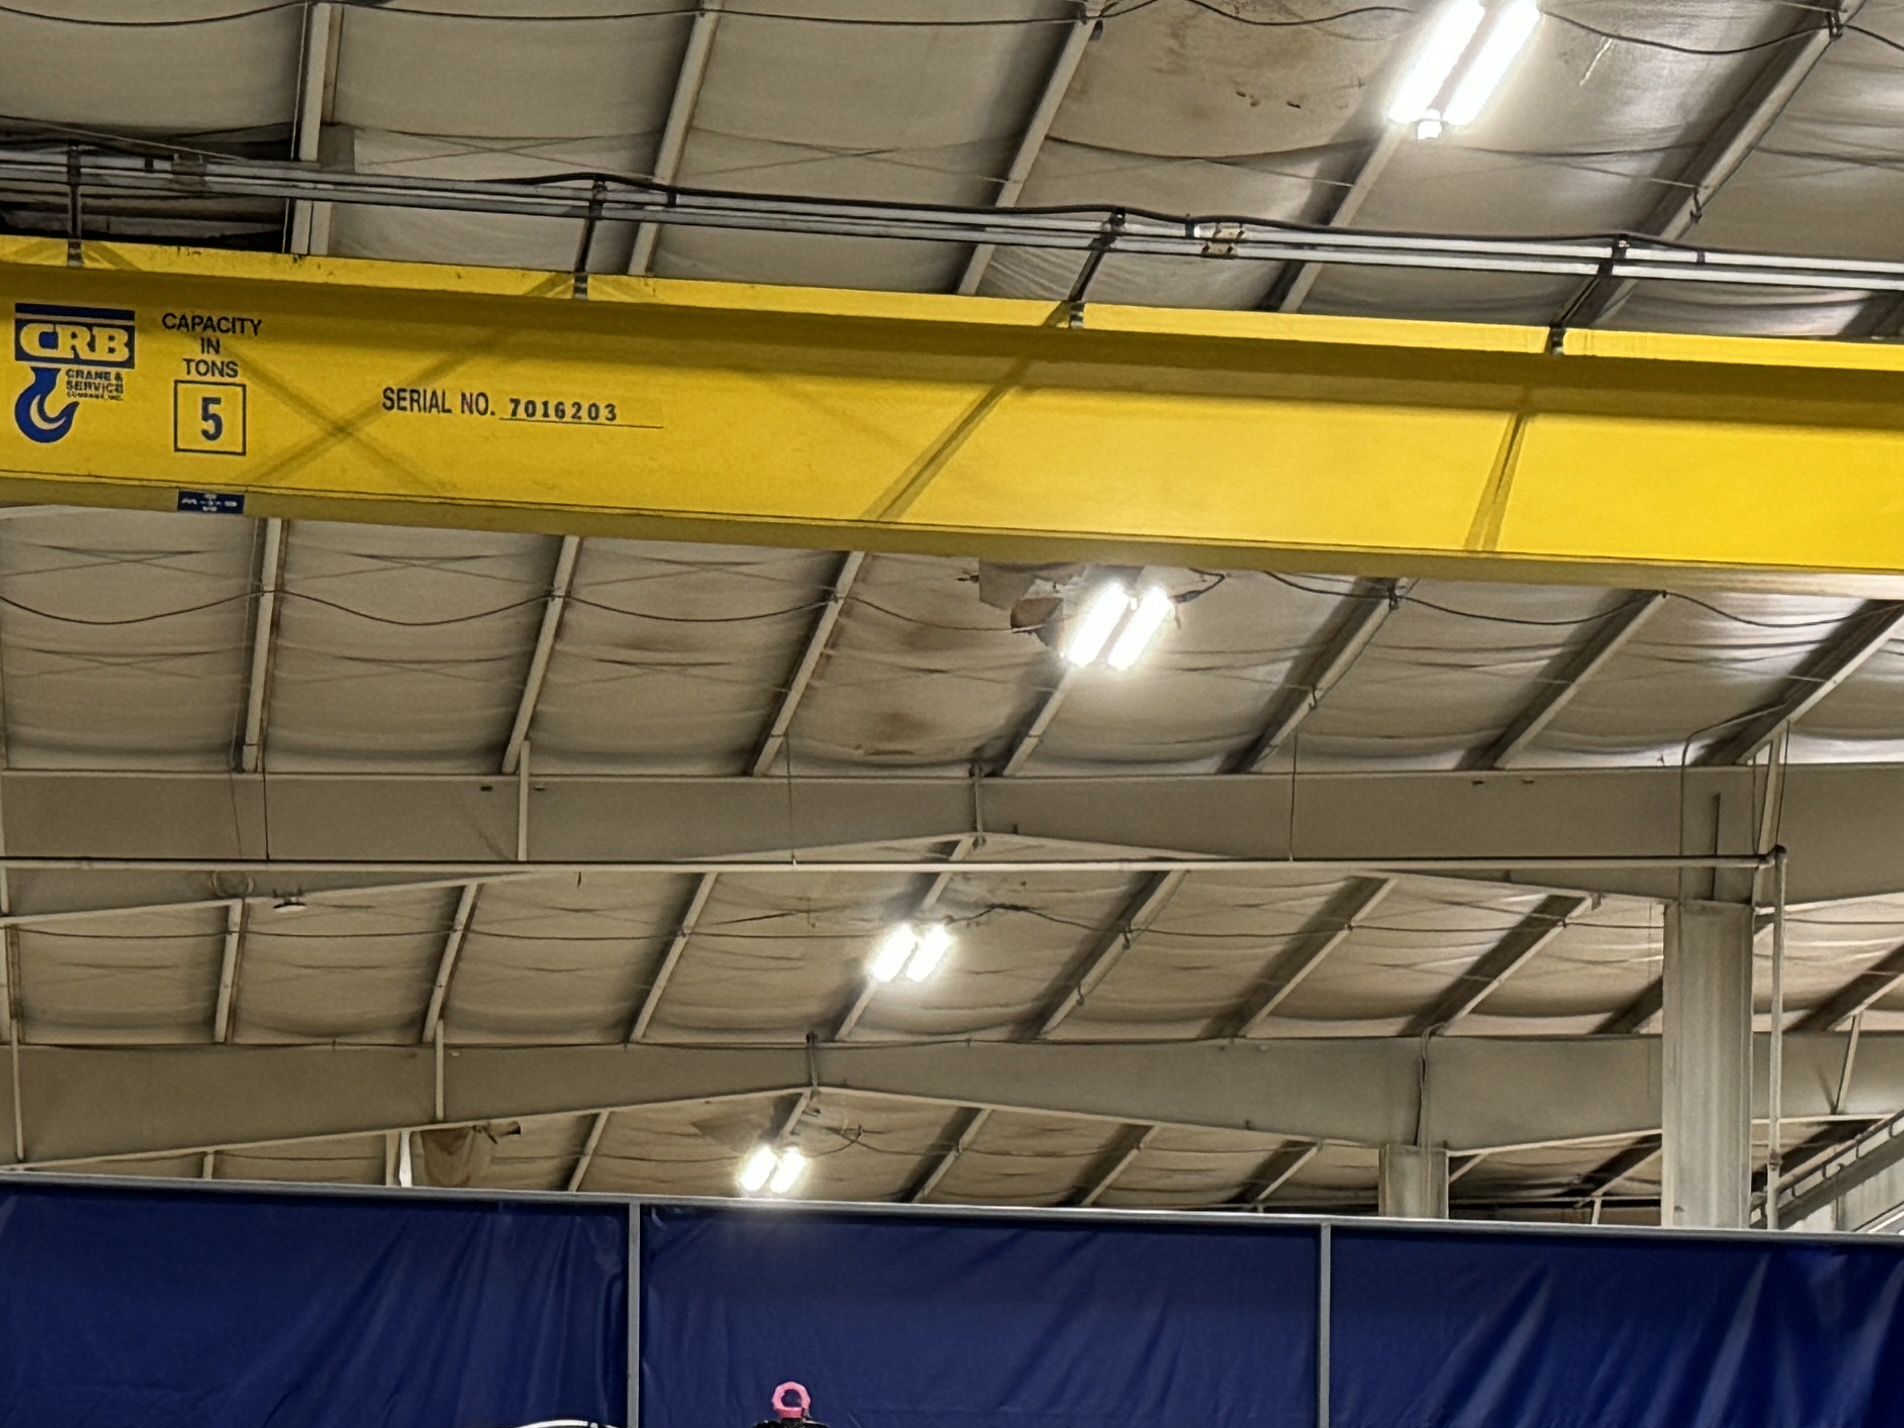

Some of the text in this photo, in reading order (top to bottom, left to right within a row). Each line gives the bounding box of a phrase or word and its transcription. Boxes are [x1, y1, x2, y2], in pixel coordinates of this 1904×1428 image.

[162, 313, 262, 336] CAPACITY
[20, 323, 130, 362] CRB
[201, 338, 221, 355] IN
[184, 358, 239, 379] TONS
[201, 396, 223, 441] 5
[382, 386, 617, 422] SERIAL NO. 7016203
